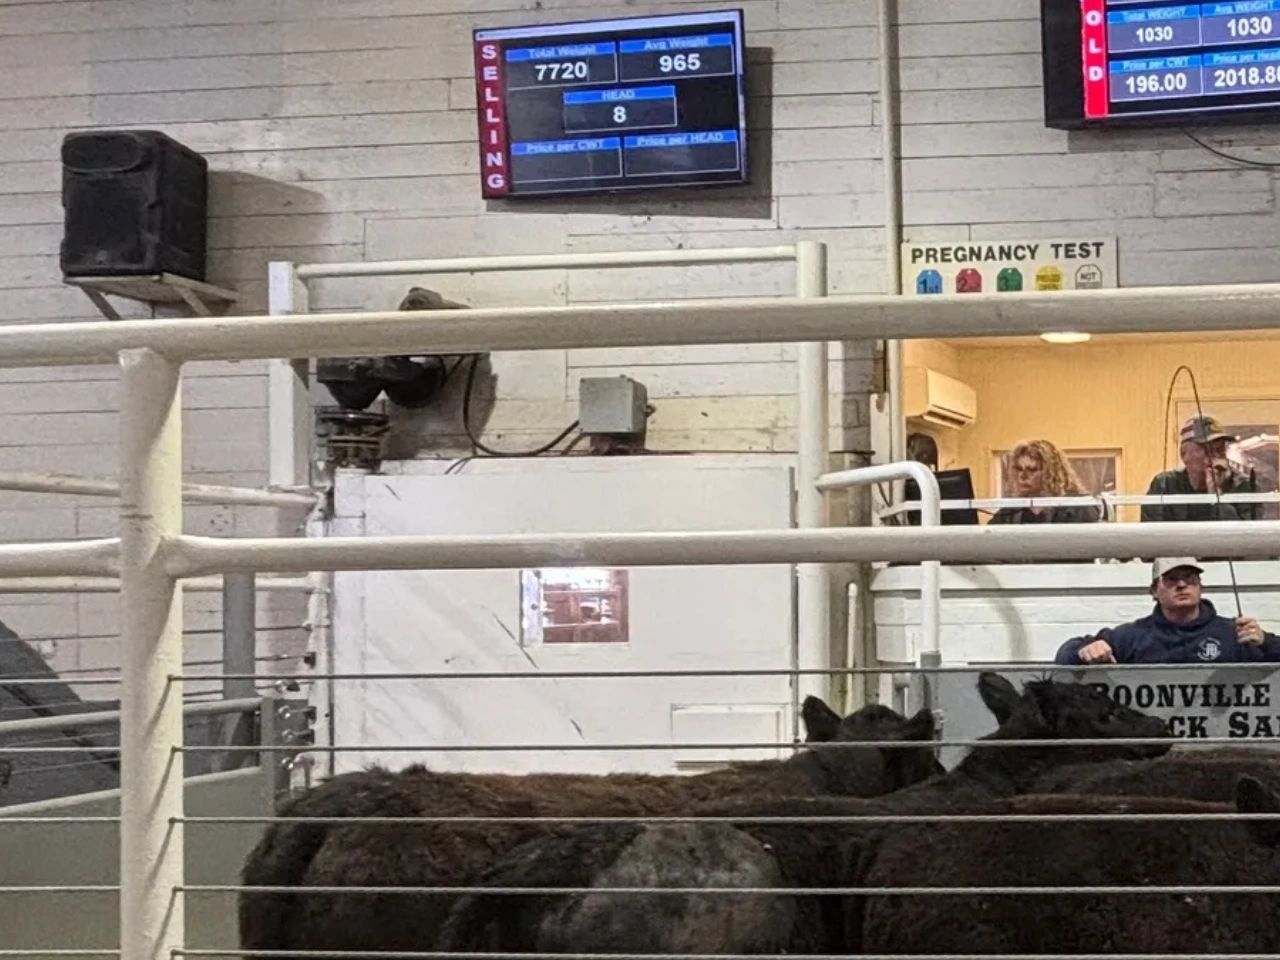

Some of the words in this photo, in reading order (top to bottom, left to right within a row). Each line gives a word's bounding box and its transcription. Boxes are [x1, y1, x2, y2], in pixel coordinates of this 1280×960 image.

[1136, 26, 1173, 42] 1030
[1227, 16, 1272, 36] 1030
[1086, 10, 1104, 81] OLD
[535, 61, 587, 80] 7720
[659, 53, 702, 72] 965
[1126, 72, 1187, 93] 196.00
[602, 90, 635, 100] HEAD
[482, 44, 505, 189] SELLING
[612, 106, 627, 123] 8
[911, 244, 1039, 264] PREGNANCY
[1051, 242, 1104, 259] TEST
